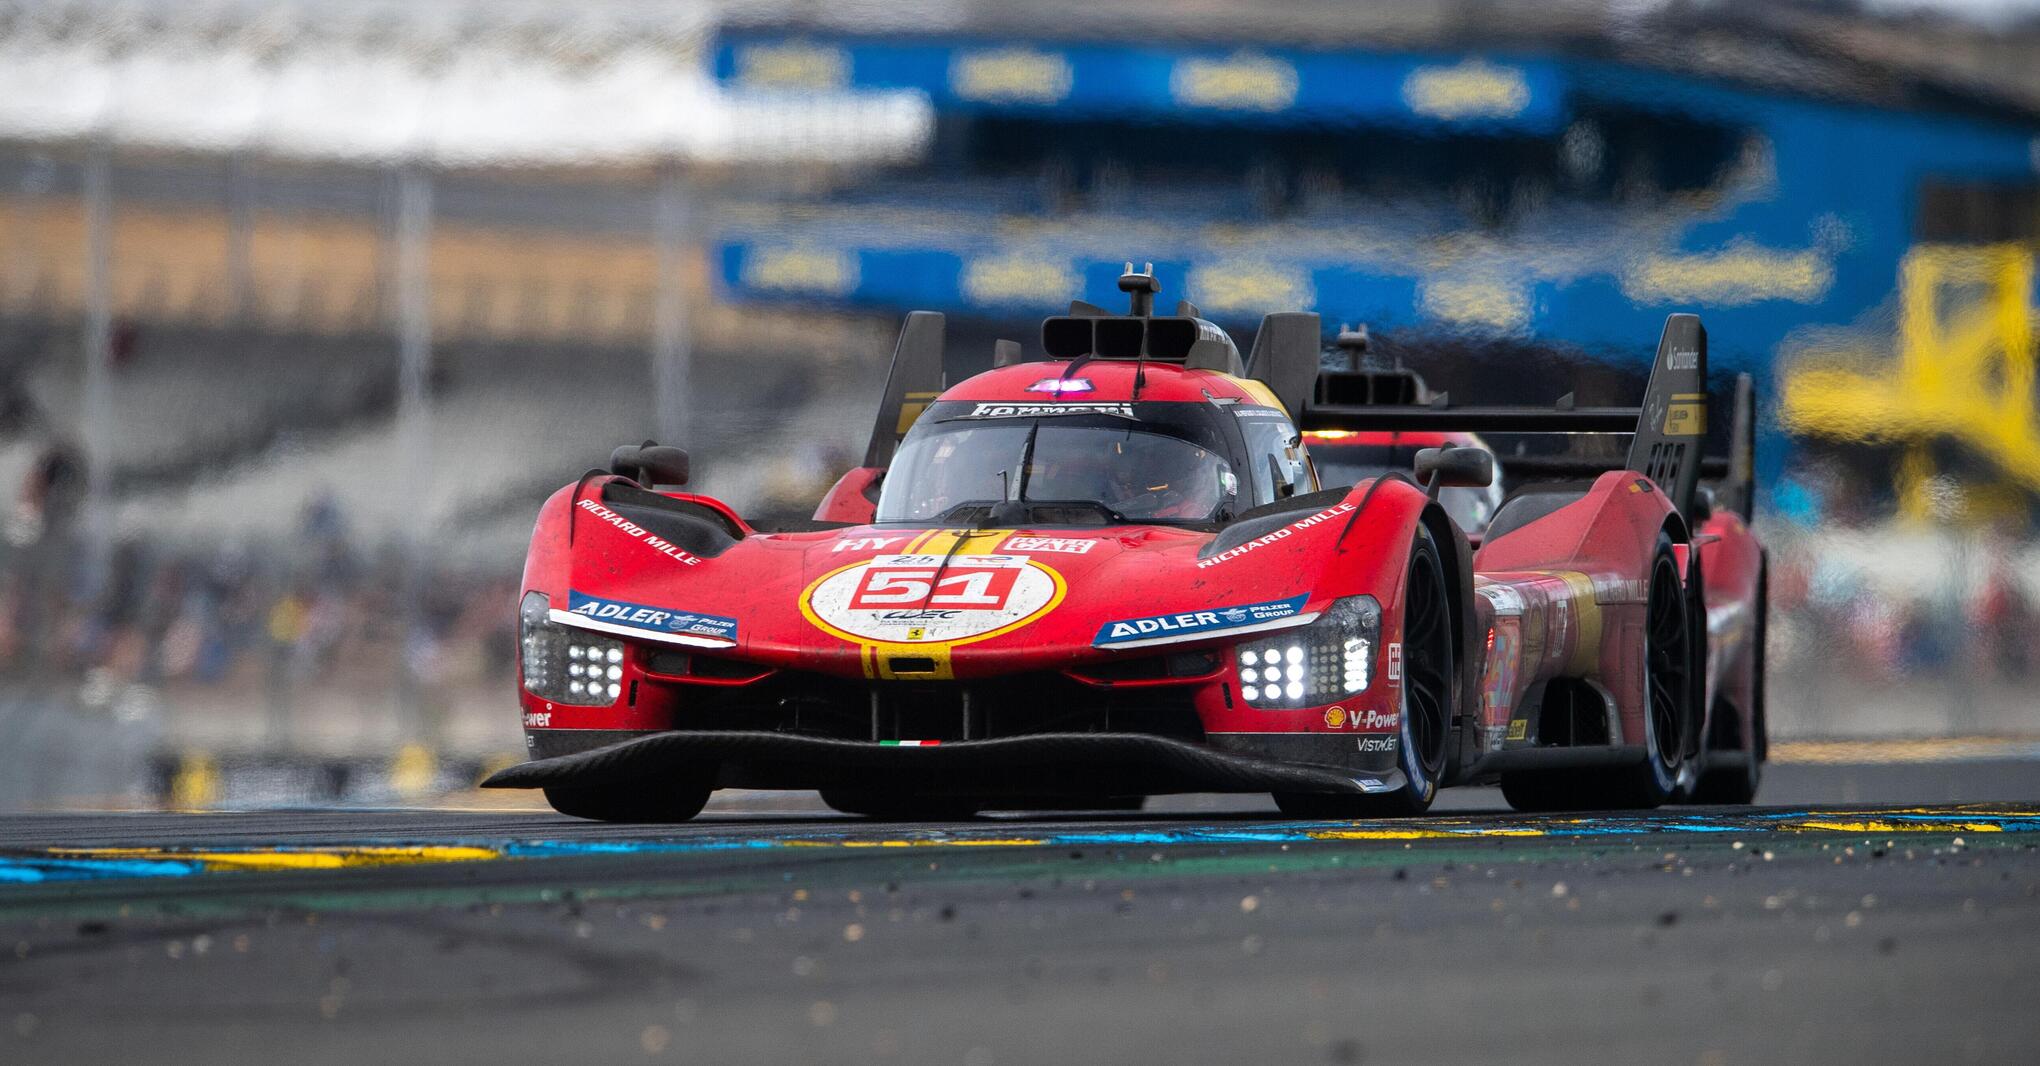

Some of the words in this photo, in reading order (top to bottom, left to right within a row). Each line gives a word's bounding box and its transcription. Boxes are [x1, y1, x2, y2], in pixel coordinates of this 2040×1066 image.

[576, 499, 647, 537] RICHARD
[644, 534, 702, 566] MILLE
[831, 537, 904, 553] HY
[1196, 528, 1292, 569] RICHARD
[1294, 502, 1357, 530] MILLE
[1010, 542, 1086, 553] CAR
[859, 571, 1002, 604] 51
[569, 601, 671, 626] ADLER
[882, 610, 963, 619] WEC
[1110, 612, 1220, 638] ADLER
[1350, 709, 1400, 729] V-Power
